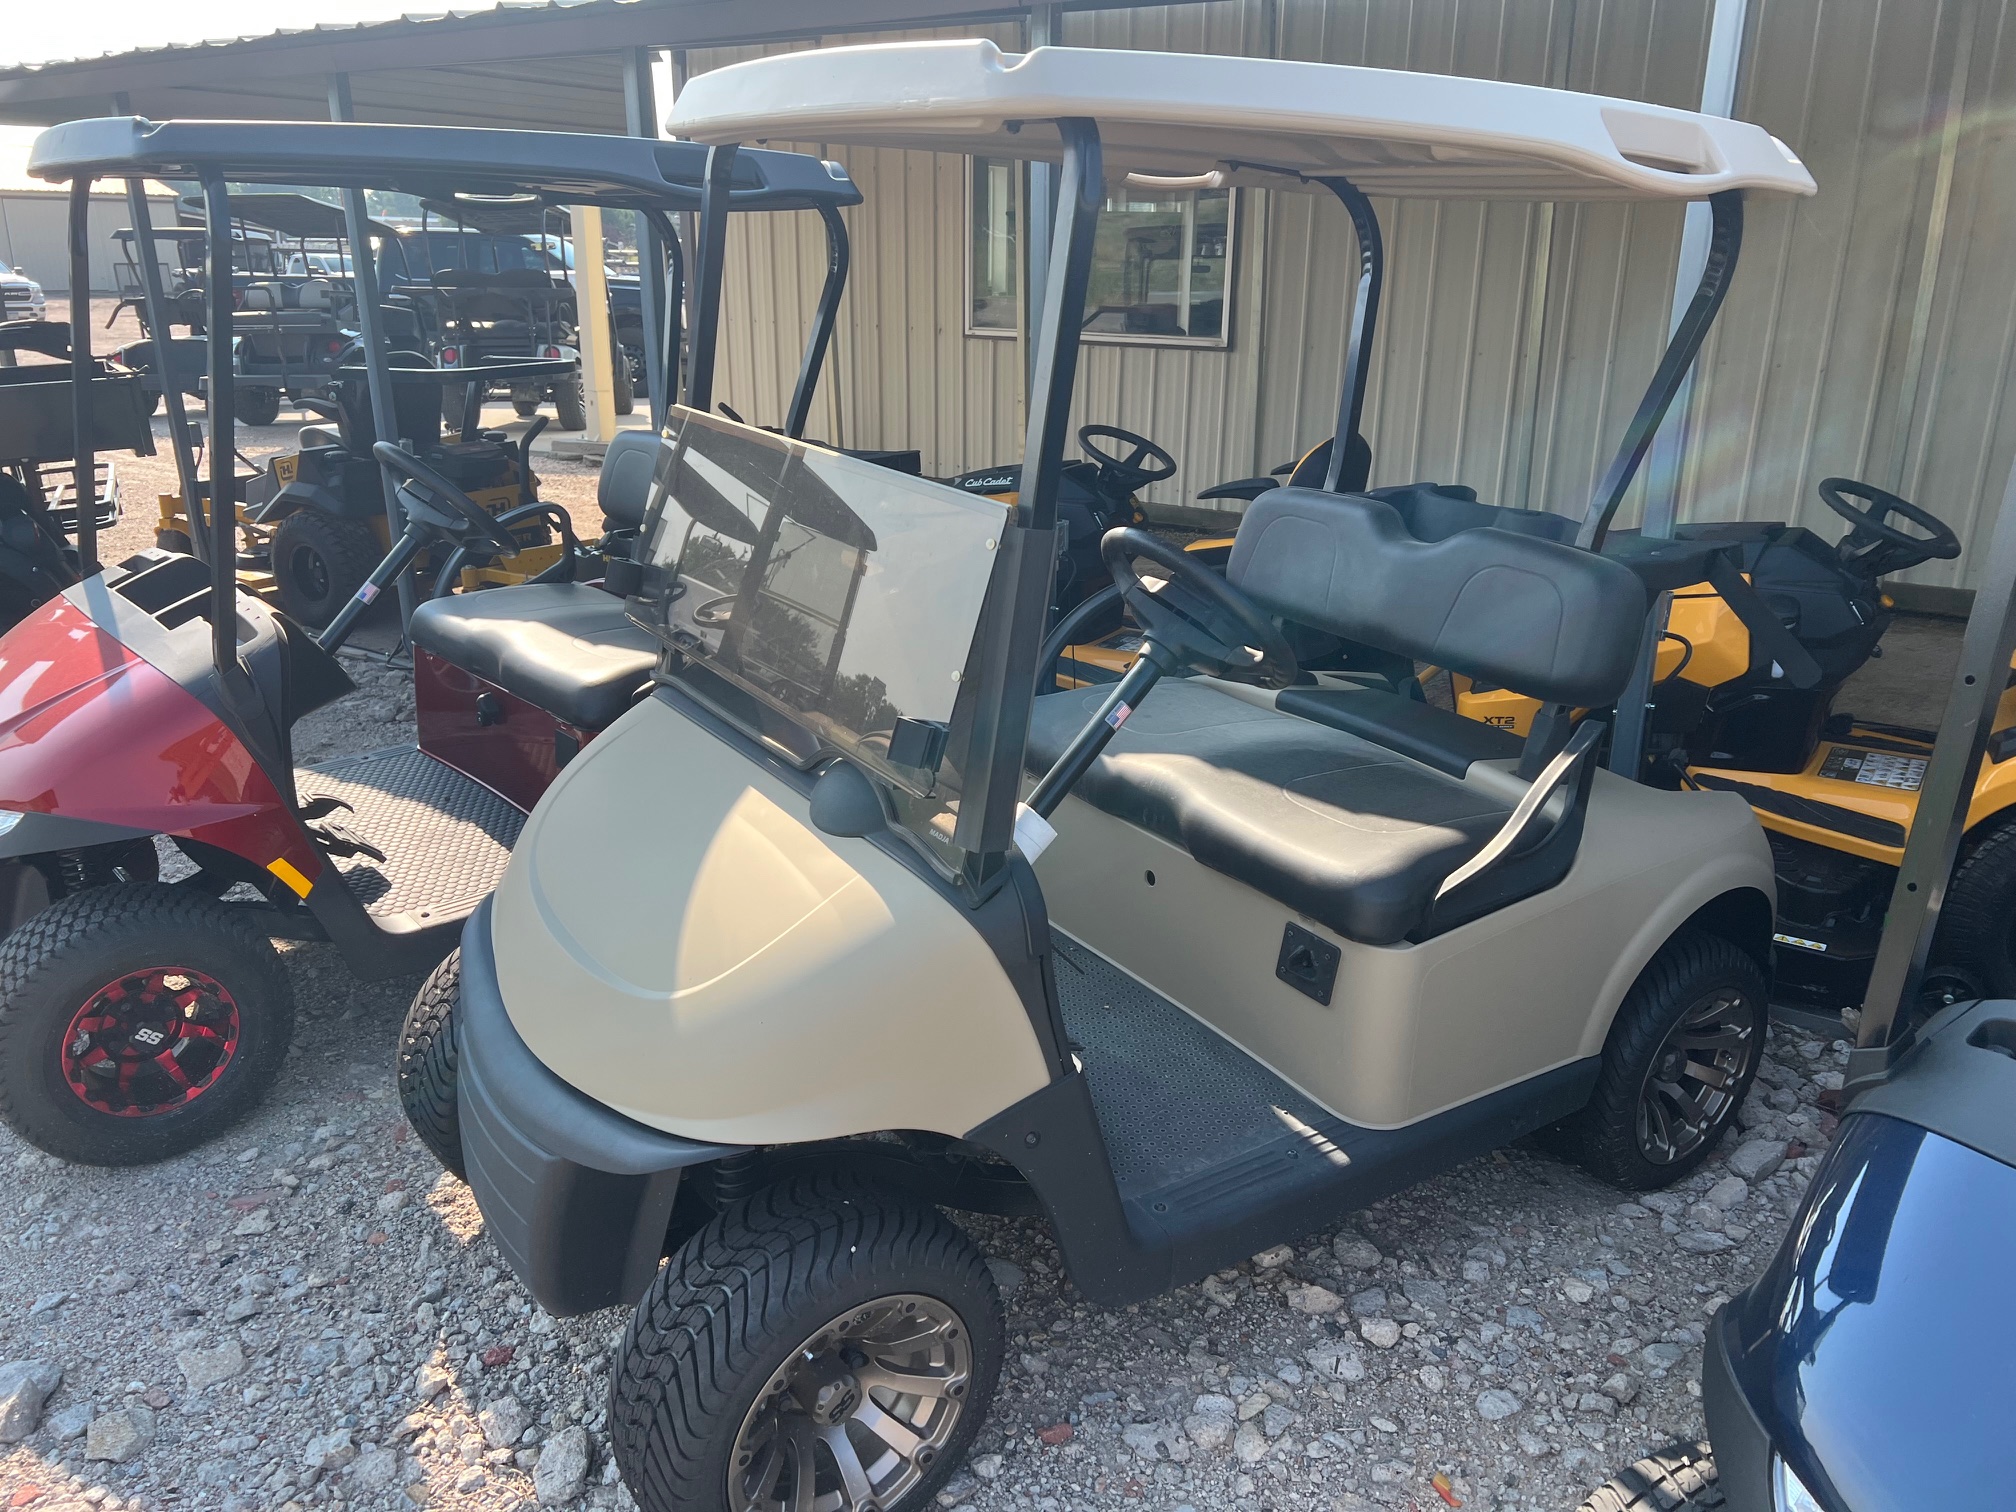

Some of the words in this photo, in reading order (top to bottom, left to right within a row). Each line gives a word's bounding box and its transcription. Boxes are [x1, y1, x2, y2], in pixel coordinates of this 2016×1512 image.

[965, 478, 983, 487] Cub
[983, 476, 1013, 486] Cadet
[1483, 716, 1515, 725] XT2
[134, 1028, 164, 1046] SS
[828, 1388, 855, 1423] SS
